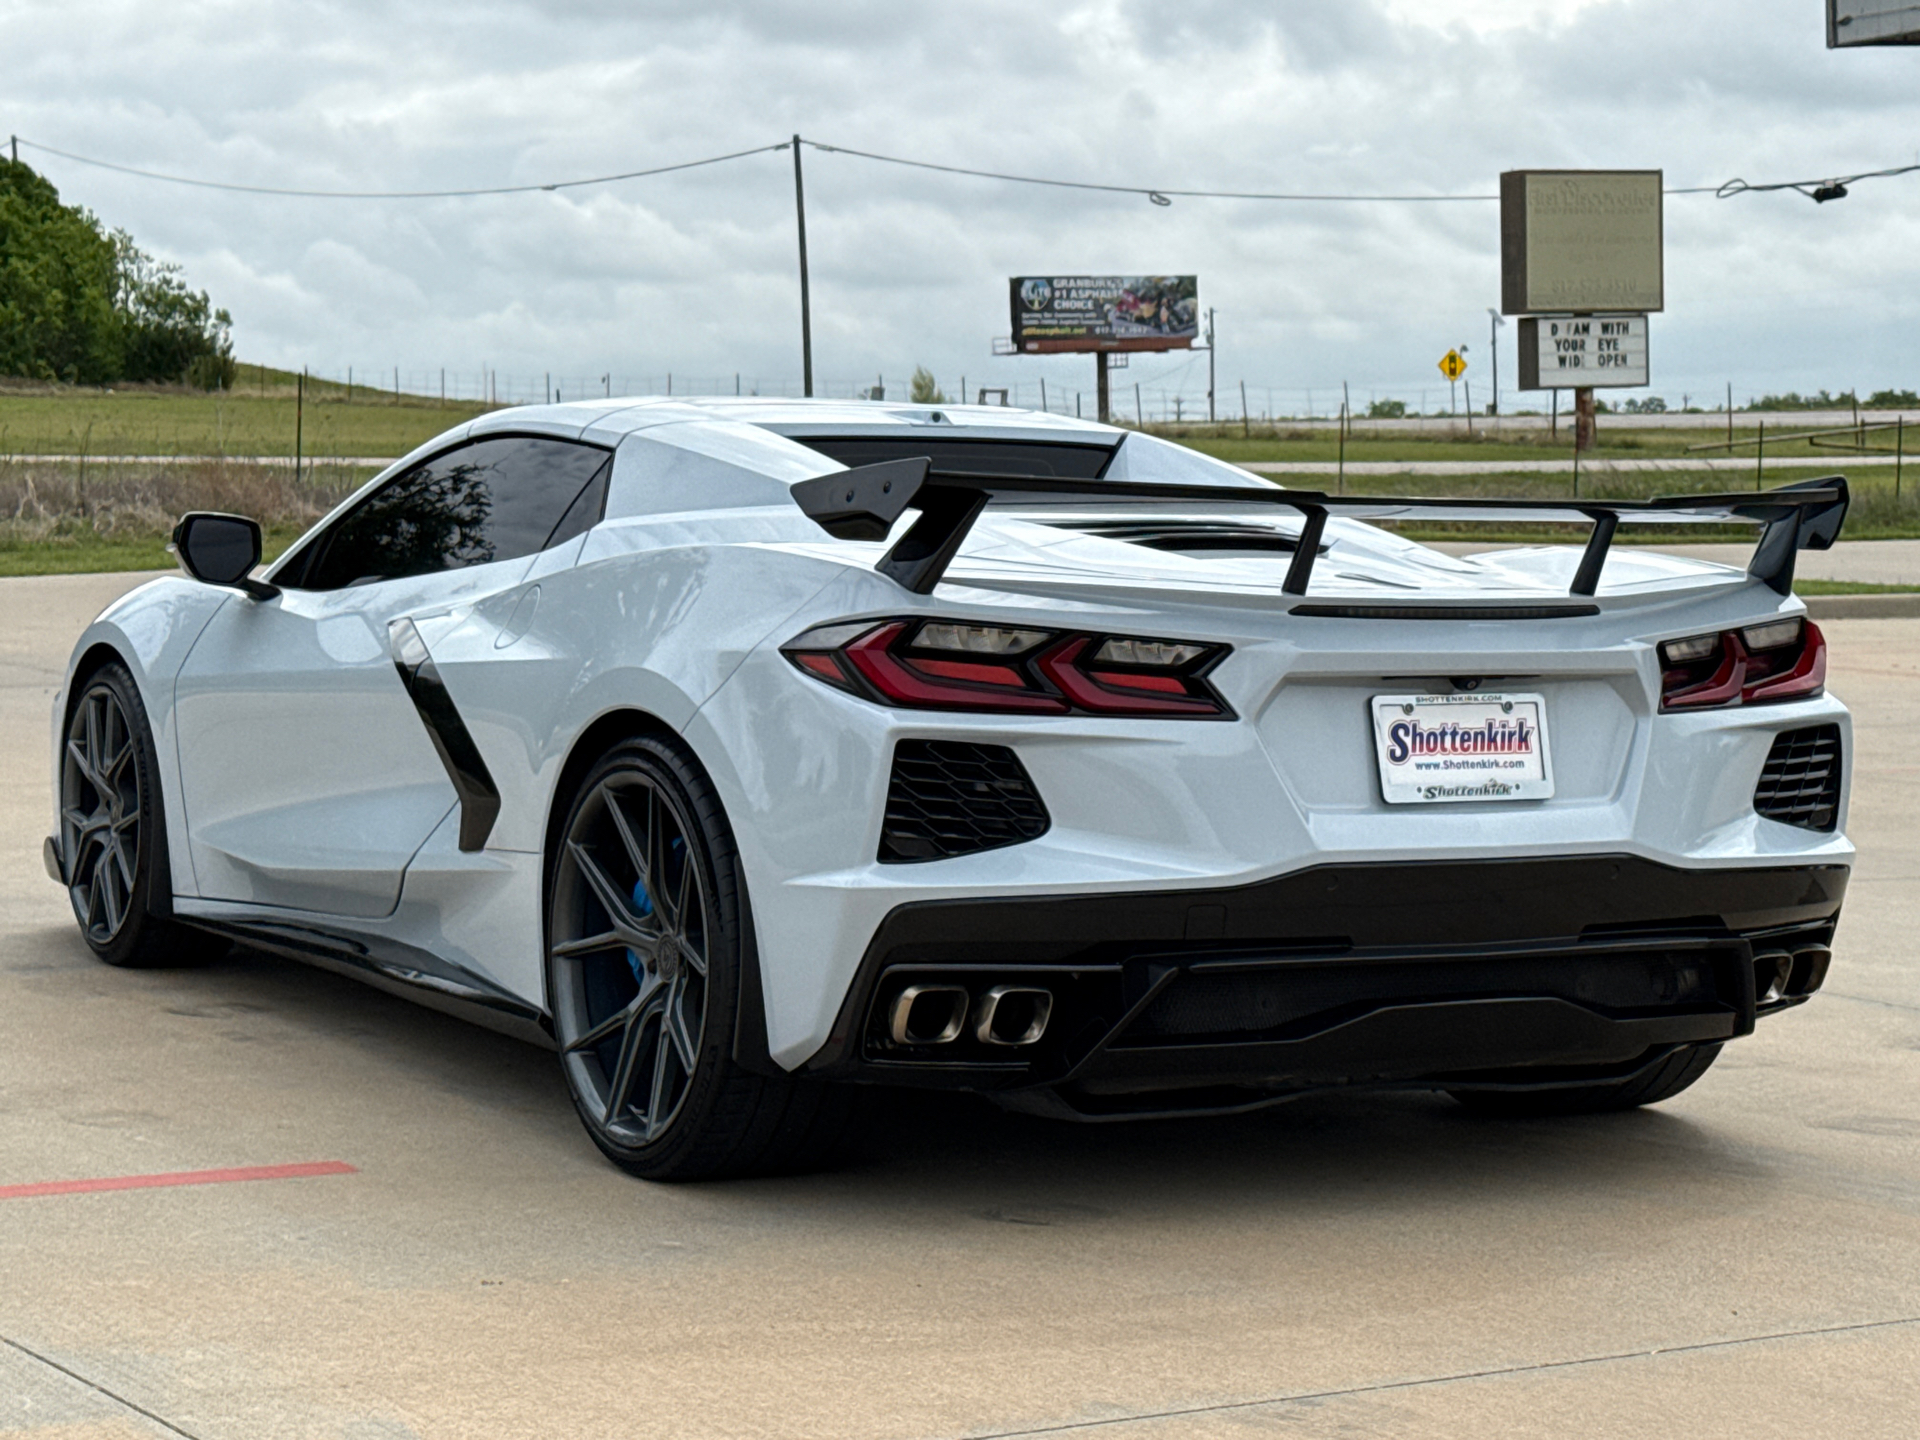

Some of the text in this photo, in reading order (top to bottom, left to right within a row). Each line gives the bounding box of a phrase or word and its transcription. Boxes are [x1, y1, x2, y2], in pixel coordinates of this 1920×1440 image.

[1053, 300, 1095, 310] CHOICE
[1601, 321, 1630, 334] WITH
[1554, 338, 1620, 352] YOUR EYE
[1557, 353, 1628, 368] WID OPEN
[1415, 695, 1502, 703] SHOTTENKIRK.COM
[1388, 719, 1534, 765] Shottenkirk
[1415, 759, 1525, 771] www.Shottenkirk.com
[1423, 782, 1513, 800] Shottenkirk
